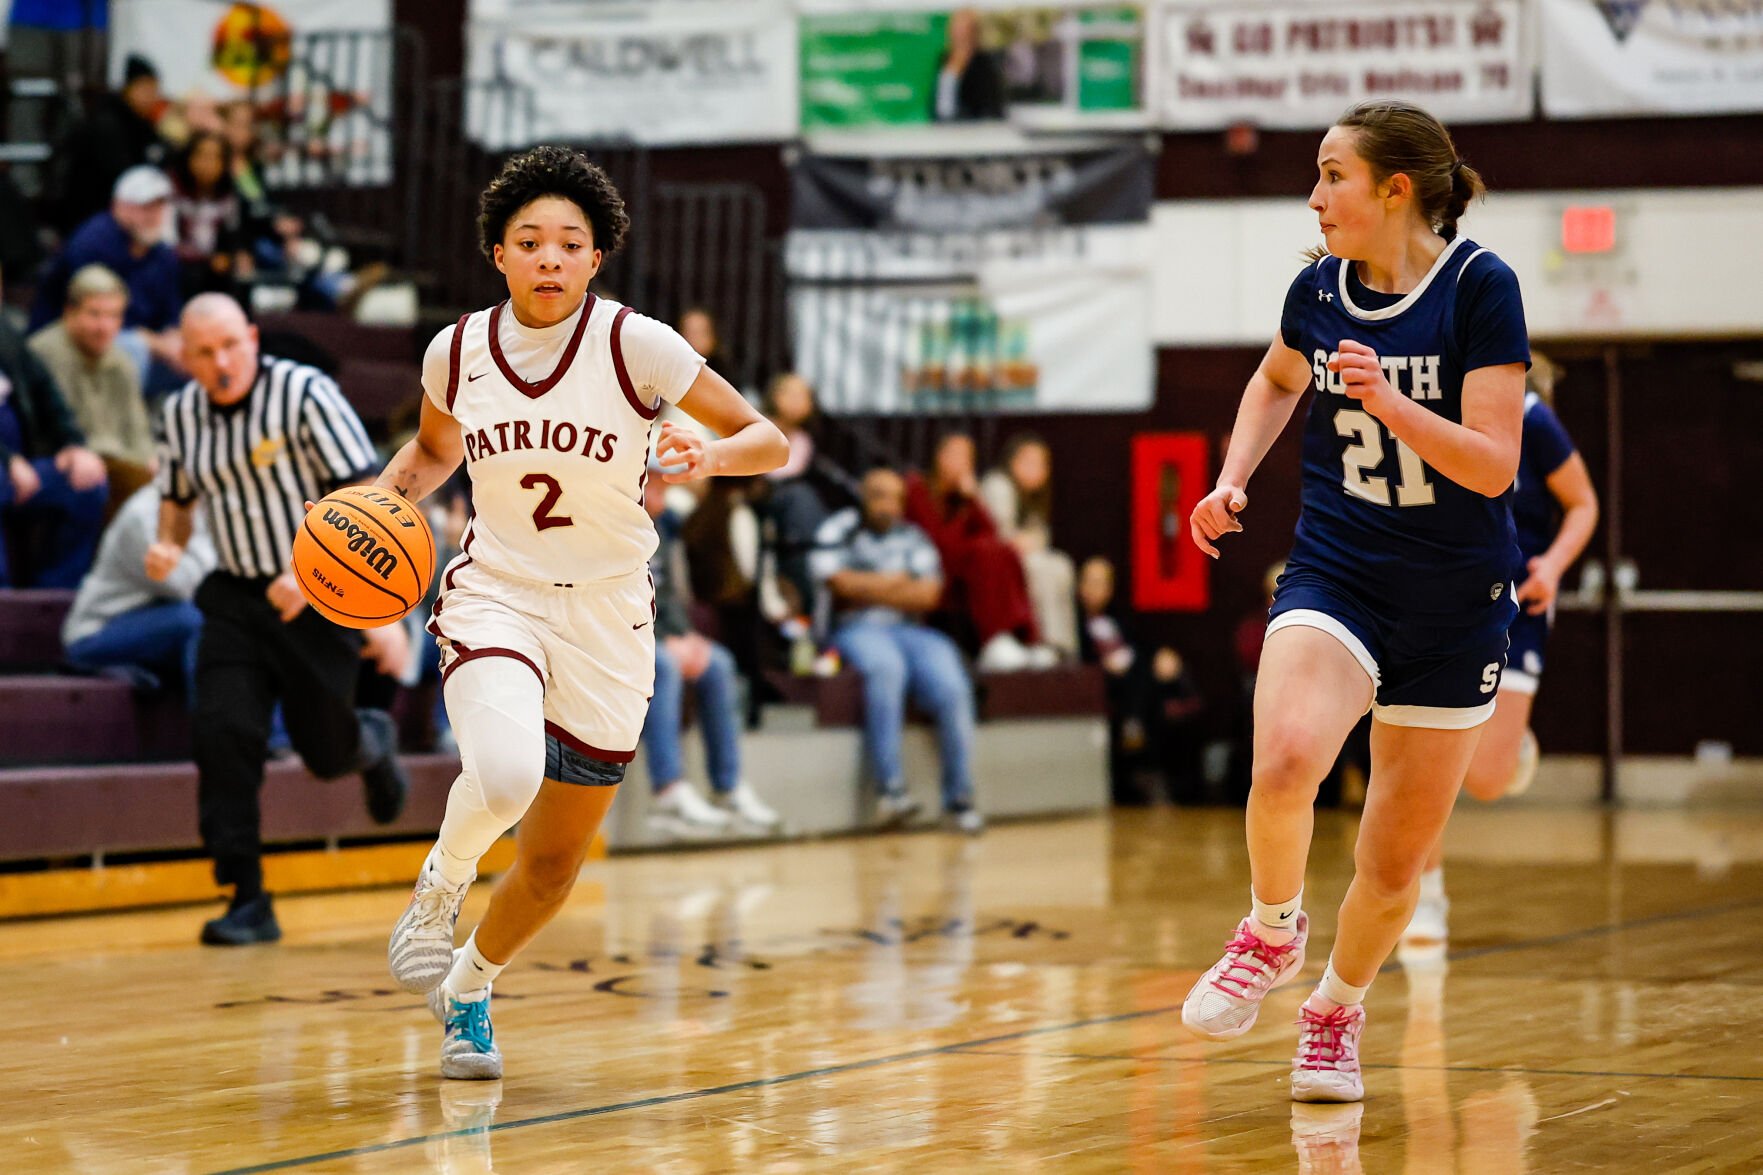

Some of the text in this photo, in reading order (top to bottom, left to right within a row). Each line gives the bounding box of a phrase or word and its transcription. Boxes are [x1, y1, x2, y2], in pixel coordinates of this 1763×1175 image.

[1313, 349, 1442, 400] SOTH
[465, 420, 618, 463] PATRIOTS
[1333, 408, 1436, 508] 21
[520, 473, 574, 532] 2
[322, 507, 398, 581] Wilson
[312, 567, 338, 593] NFHS
[1479, 661, 1500, 694] S
